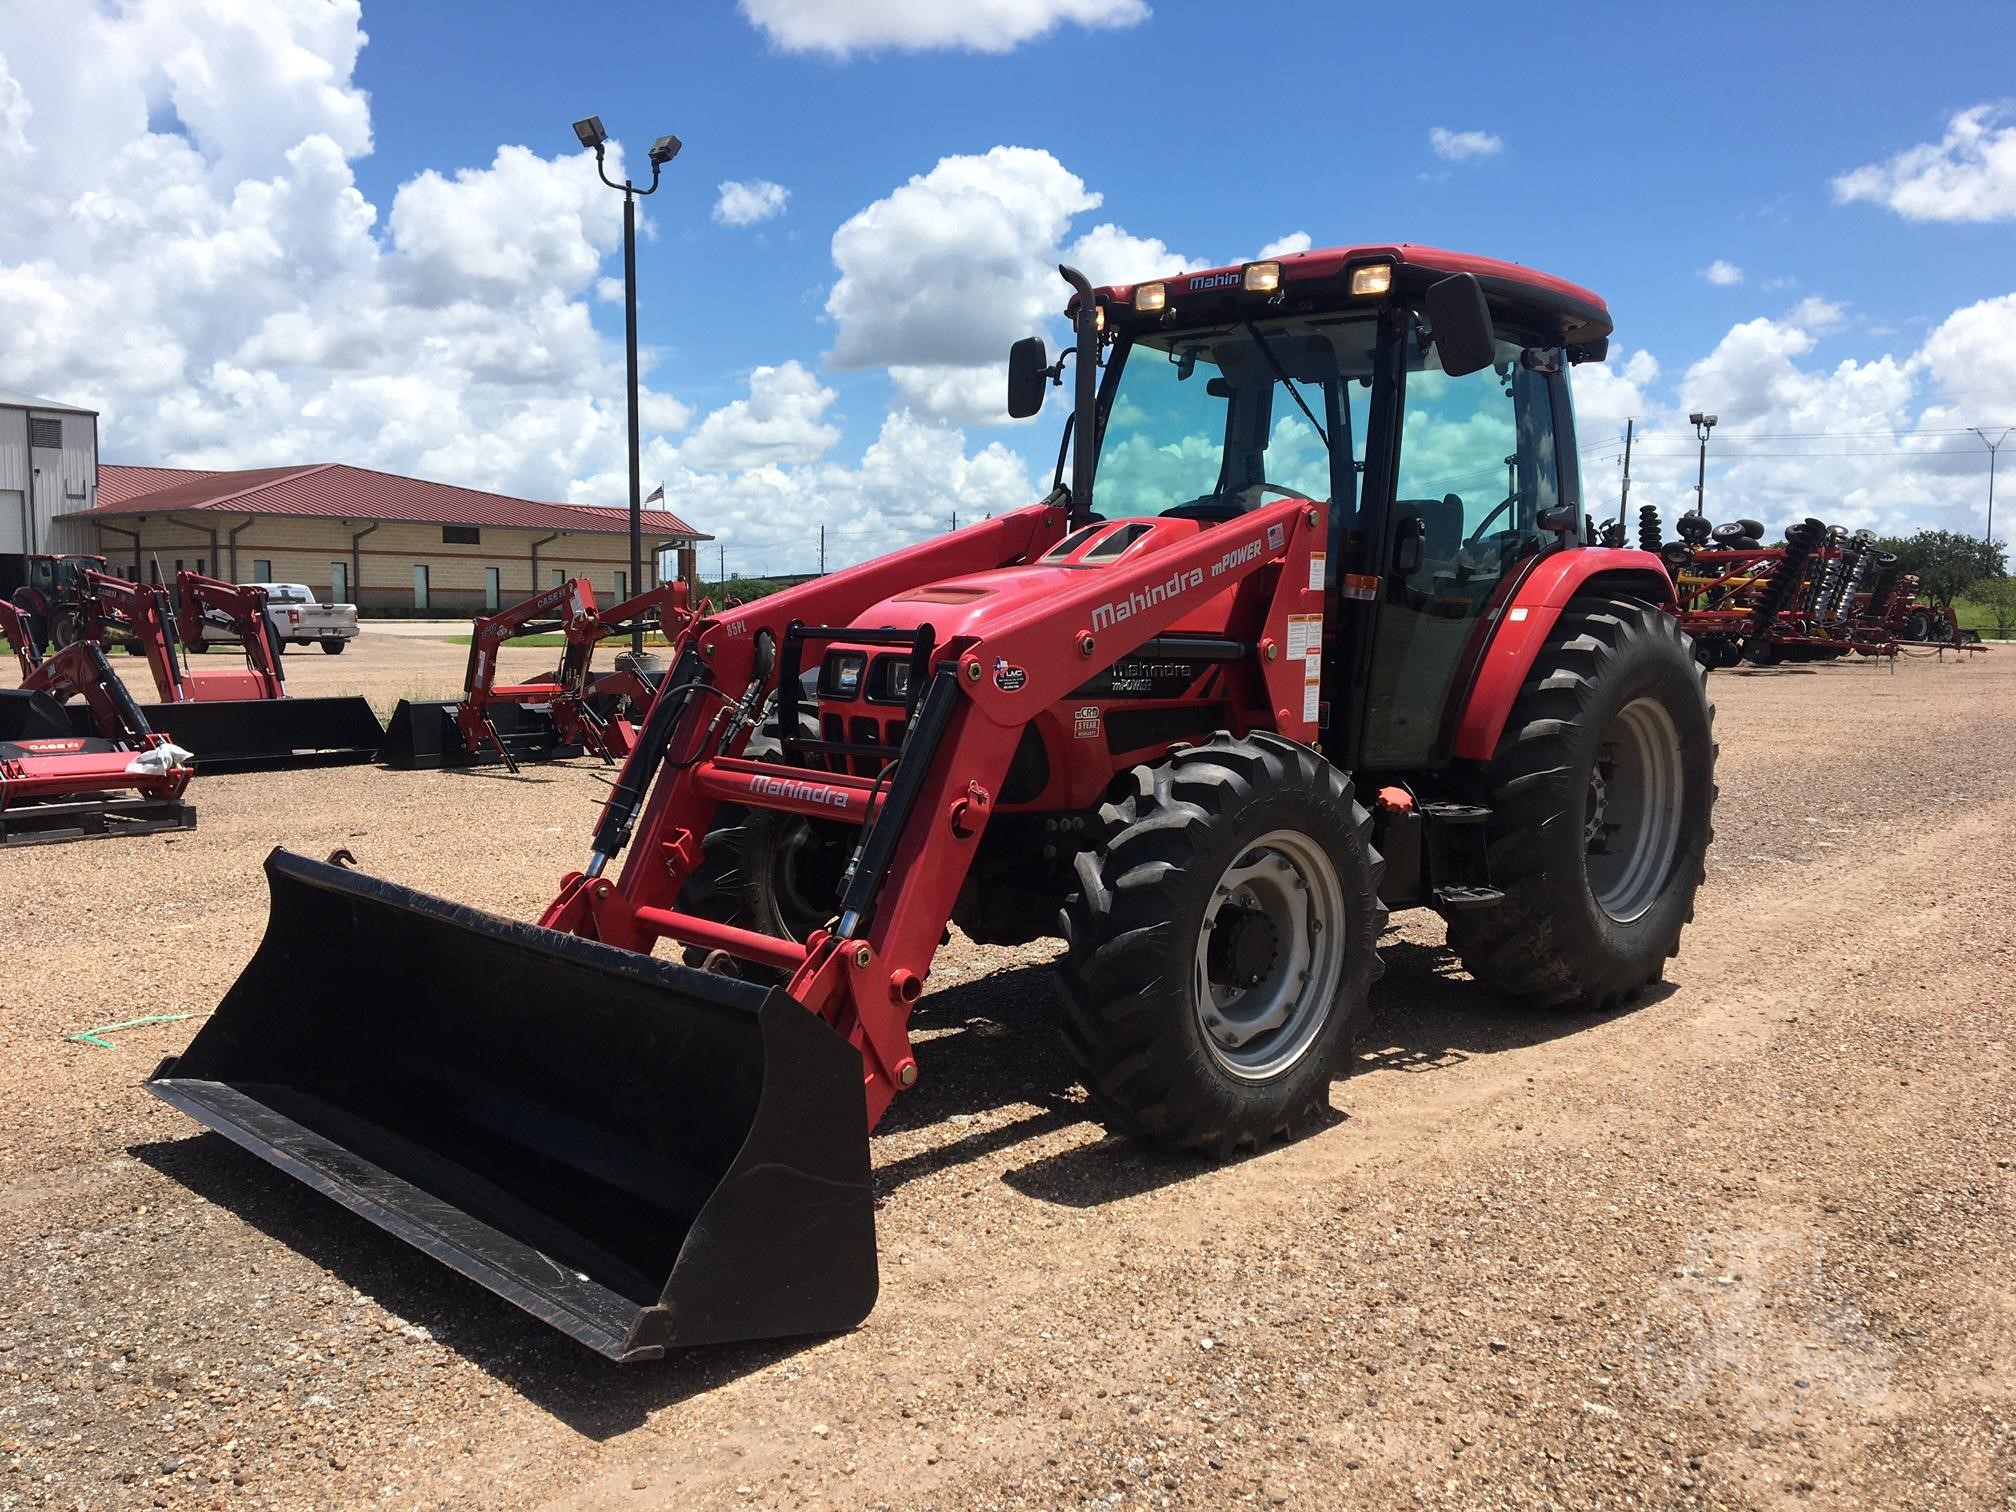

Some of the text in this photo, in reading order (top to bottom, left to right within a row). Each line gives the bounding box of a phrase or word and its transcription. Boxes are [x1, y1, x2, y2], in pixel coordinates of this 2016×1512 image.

[1189, 272, 1242, 290] Mahin
[1091, 567, 1204, 632] Mahindra
[1211, 539, 1262, 577] mPOWER
[1112, 662, 1192, 677] Mahindra
[749, 775, 849, 808] Mahindra
